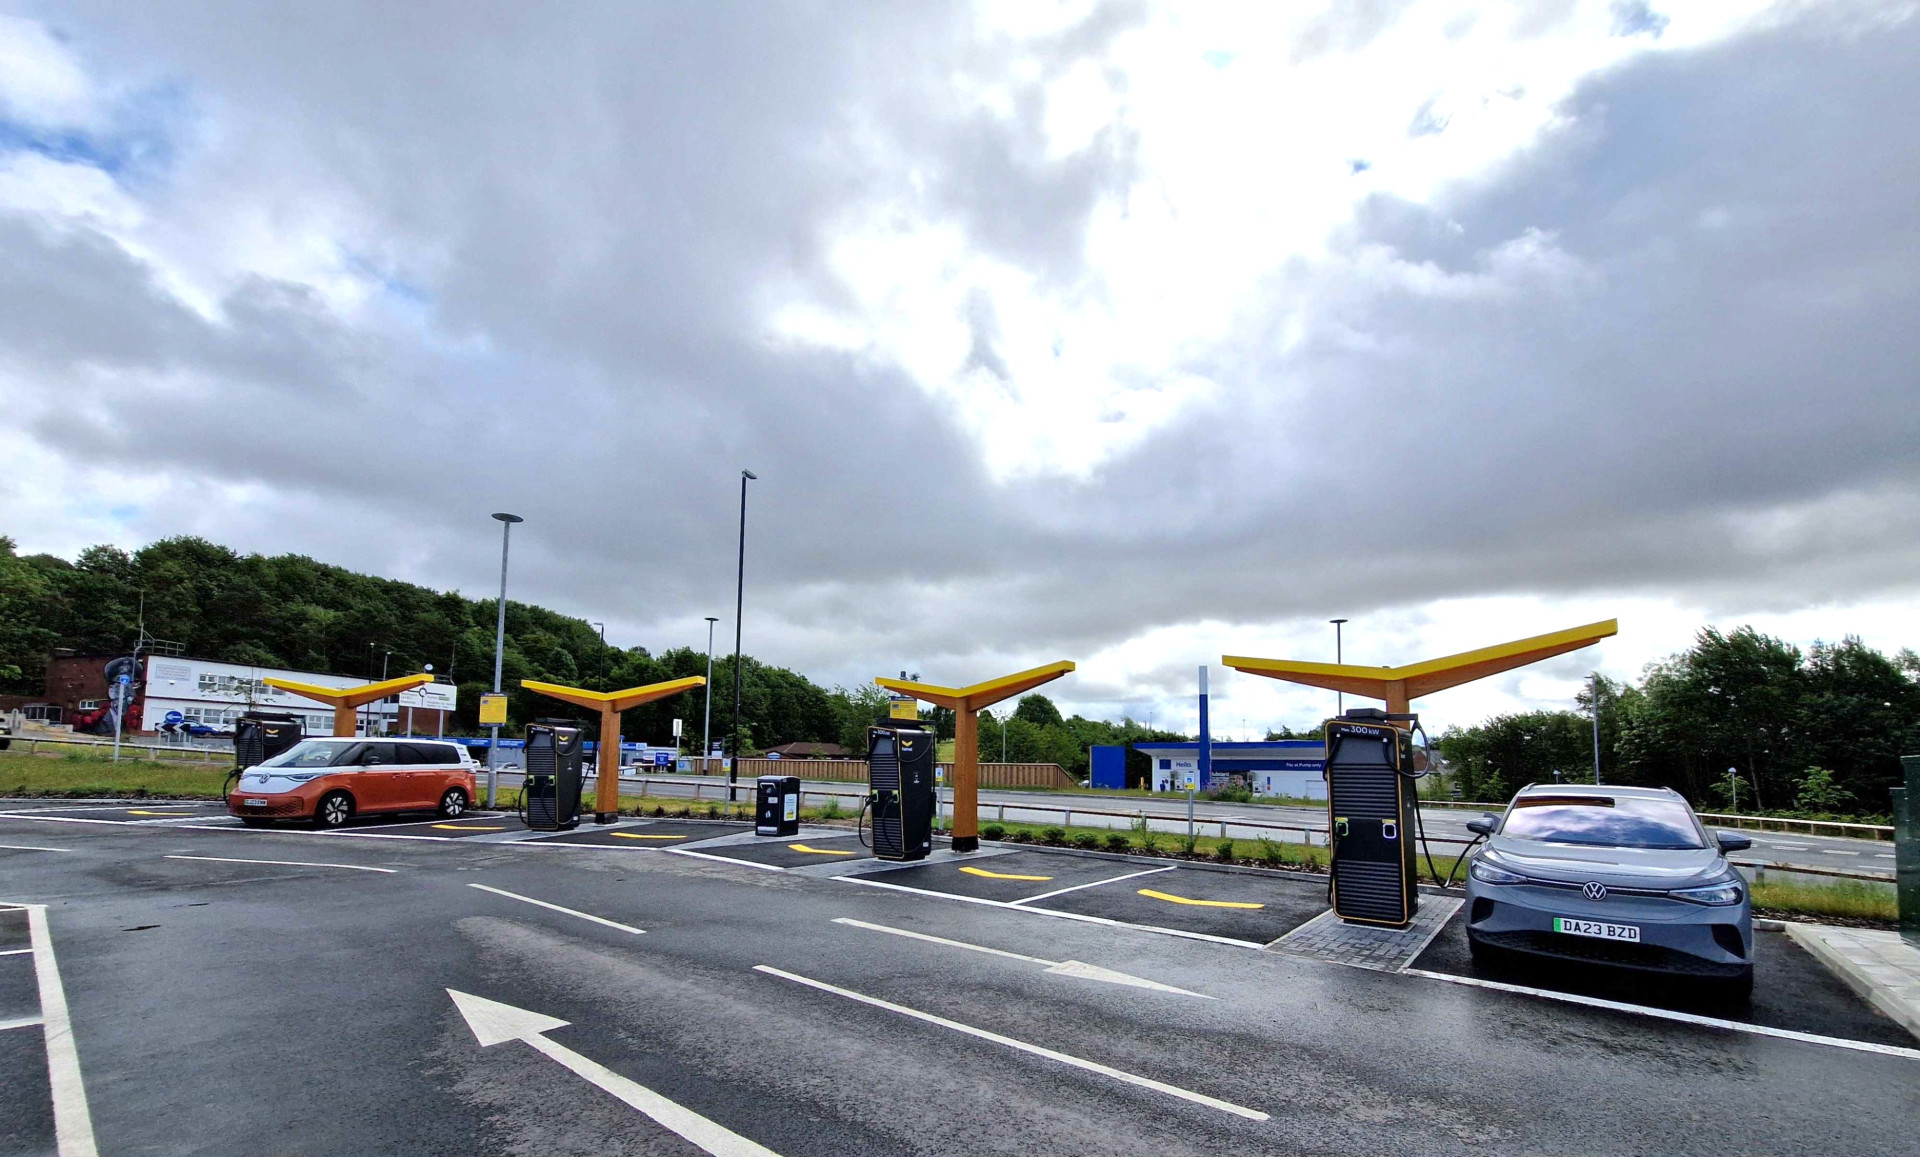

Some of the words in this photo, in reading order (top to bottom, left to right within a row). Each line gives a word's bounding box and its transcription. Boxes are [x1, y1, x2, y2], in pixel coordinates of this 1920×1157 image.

[1350, 726, 1368, 734] 300
[1563, 920, 1602, 935] DA23
[1606, 925, 1637, 939] BZD
